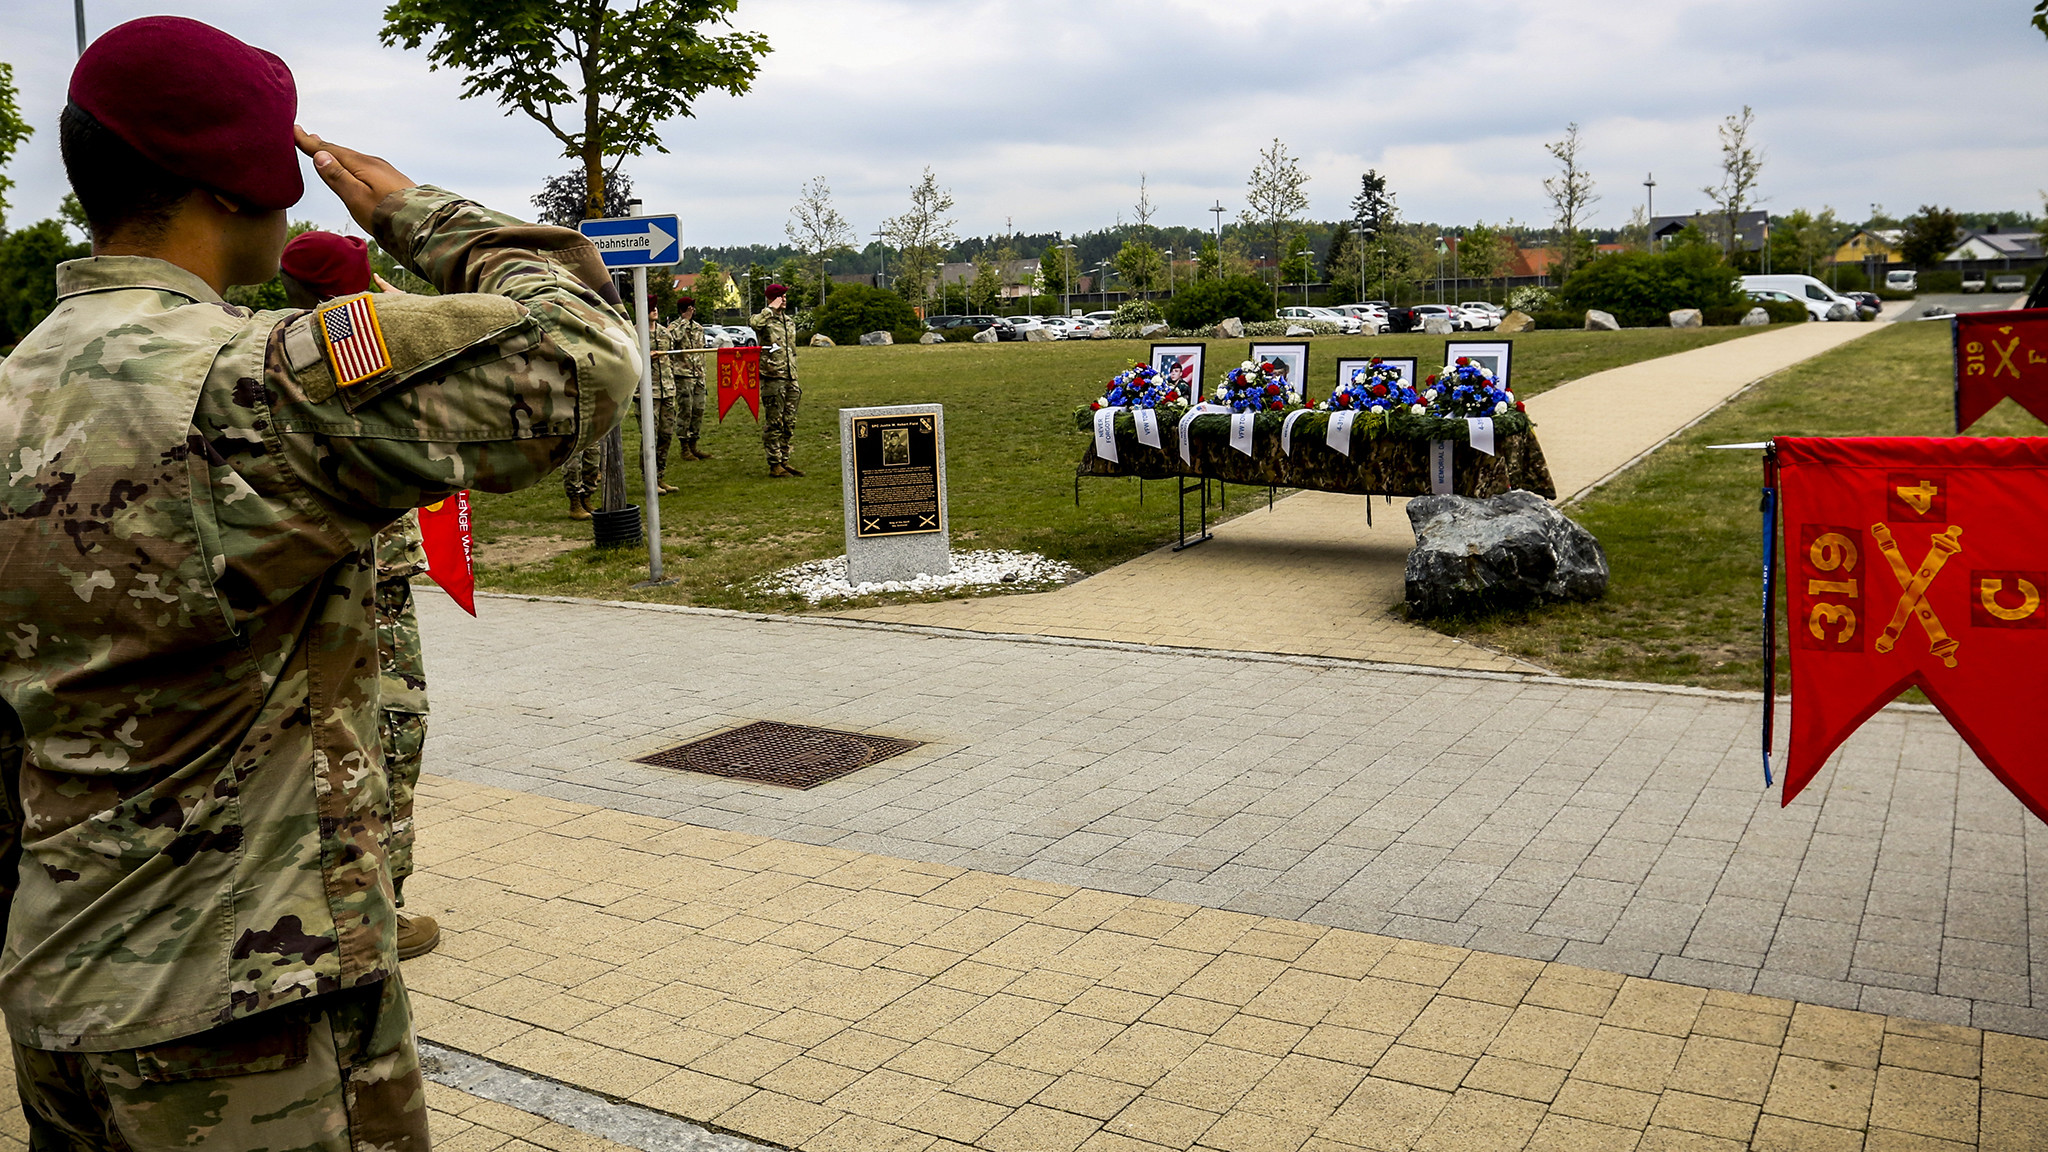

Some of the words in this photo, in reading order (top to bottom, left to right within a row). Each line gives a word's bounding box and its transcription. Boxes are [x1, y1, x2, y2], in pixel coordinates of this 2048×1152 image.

[592, 236, 650, 249] nbahnstraße
[1998, 325, 2013, 335] 4
[1966, 341, 1985, 376] 319
[2028, 349, 2047, 364] F
[747, 362, 756, 388] 319
[1896, 480, 1938, 515] 4
[1808, 532, 1858, 644] 319
[1981, 578, 2040, 620] C
